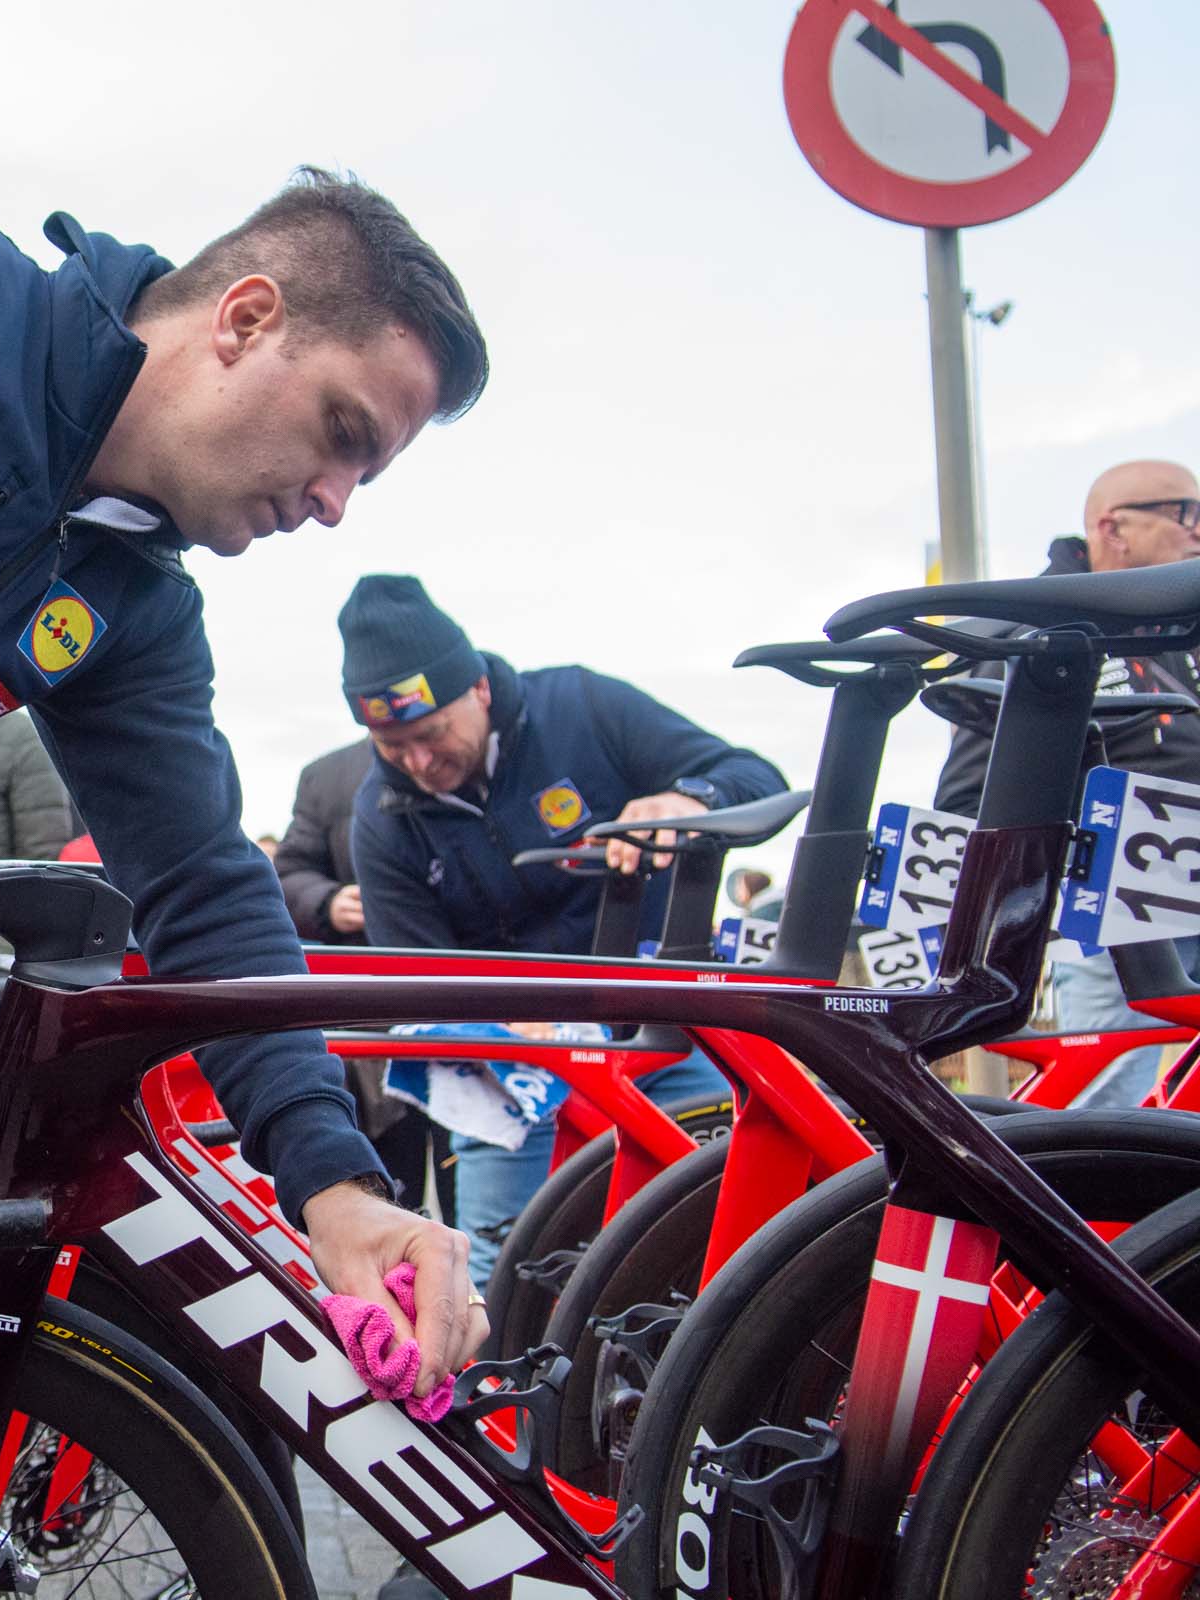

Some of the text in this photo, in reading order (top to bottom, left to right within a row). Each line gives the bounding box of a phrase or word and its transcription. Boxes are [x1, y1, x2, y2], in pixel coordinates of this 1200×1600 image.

[40, 612, 81, 659] LIDL
[1091, 800, 1115, 827] N
[899, 821, 969, 914] 133
[1115, 786, 1200, 923] 131
[1074, 887, 1100, 914] N
[824, 996, 889, 1013] PEDERSEN
[81, 1337, 113, 1355] VELO
